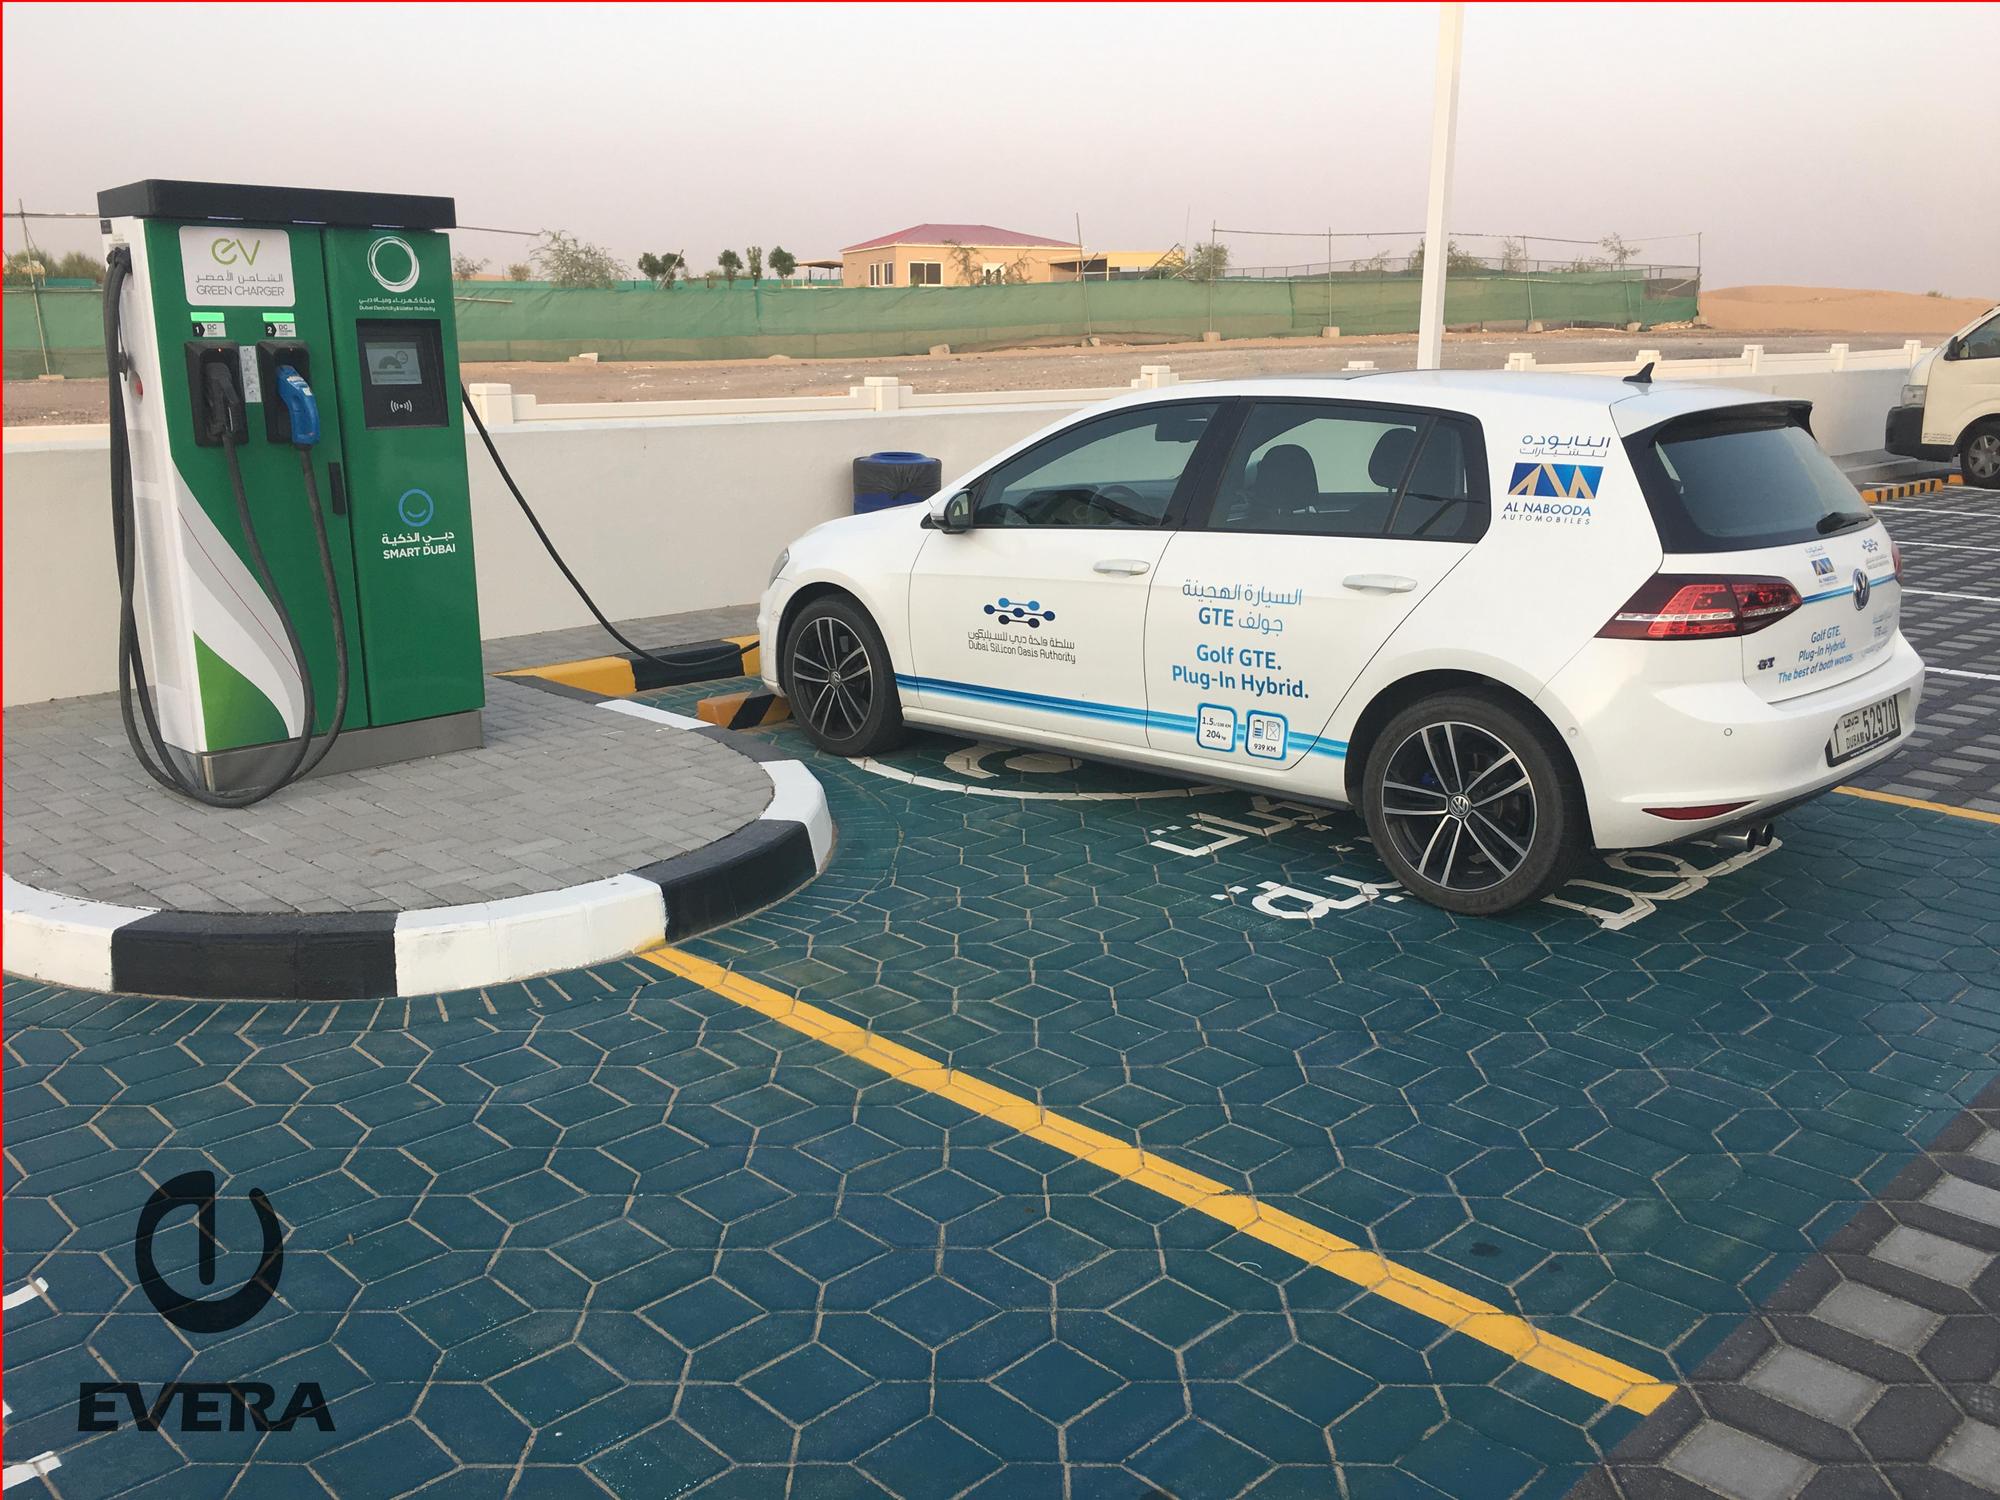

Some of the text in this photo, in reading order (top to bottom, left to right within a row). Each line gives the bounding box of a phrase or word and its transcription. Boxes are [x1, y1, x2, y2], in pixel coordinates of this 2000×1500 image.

[196, 285, 285, 296] GREEN CHARGER
[195, 326, 200, 334] 1
[267, 326, 273, 334] 2
[1504, 502, 1591, 517] AL NABOODA
[1501, 514, 1590, 525] AUTOMOBILES
[381, 531, 455, 546] دبي الذكية
[383, 544, 456, 559] SMART DUBAI
[1182, 579, 1302, 608] السيارة الهجينة
[1198, 607, 1283, 637] جولف GTE
[1009, 634, 1027, 644] دبي
[1811, 627, 1826, 643] Golf
[1049, 637, 1075, 650] سلطة
[968, 640, 1076, 664] Dubai Silicon Oasis Authority
[1196, 644, 1282, 670] Golf GTE.
[1798, 646, 1824, 662] Plug-In
[1778, 671, 1792, 684] The
[1793, 666, 1809, 679] best
[1810, 663, 1818, 674] of
[1172, 665, 1309, 699] Plug-In Hybrid.
[1862, 698, 1897, 742] 52970
[1206, 729, 1221, 739] 204
[1254, 743, 1277, 752] 939 KM
